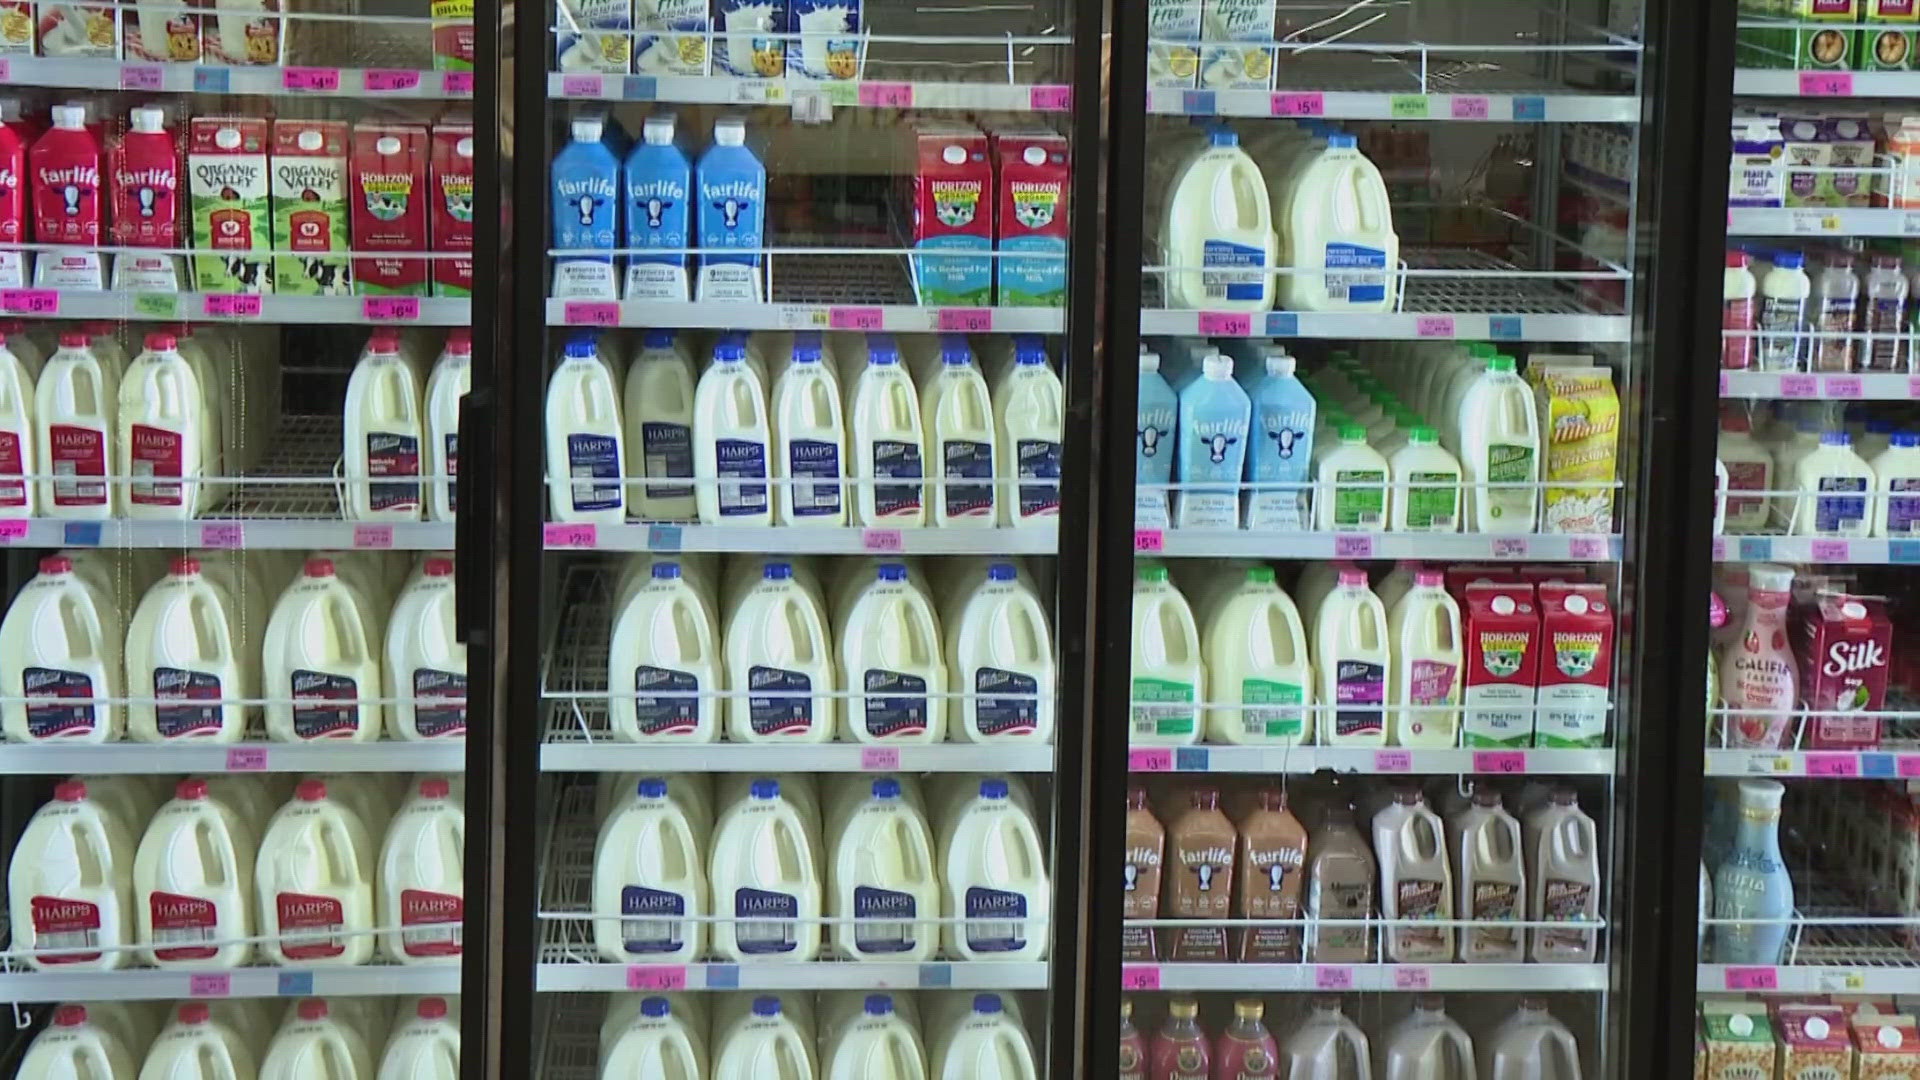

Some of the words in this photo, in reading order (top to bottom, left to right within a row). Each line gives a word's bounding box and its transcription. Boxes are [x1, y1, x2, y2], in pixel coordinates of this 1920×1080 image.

[197, 163, 258, 179] ORGANIC
[279, 165, 340, 180] ORGANIC
[361, 172, 413, 184] HORIZON
[932, 181, 981, 192] HORIZON
[1011, 181, 1061, 193] HORIZON
[1481, 632, 1529, 642] HORIZON
[1554, 632, 1602, 643] HORIZON
[1823, 639, 1886, 677] Silk
[1736, 657, 1792, 675] CALIFIA
